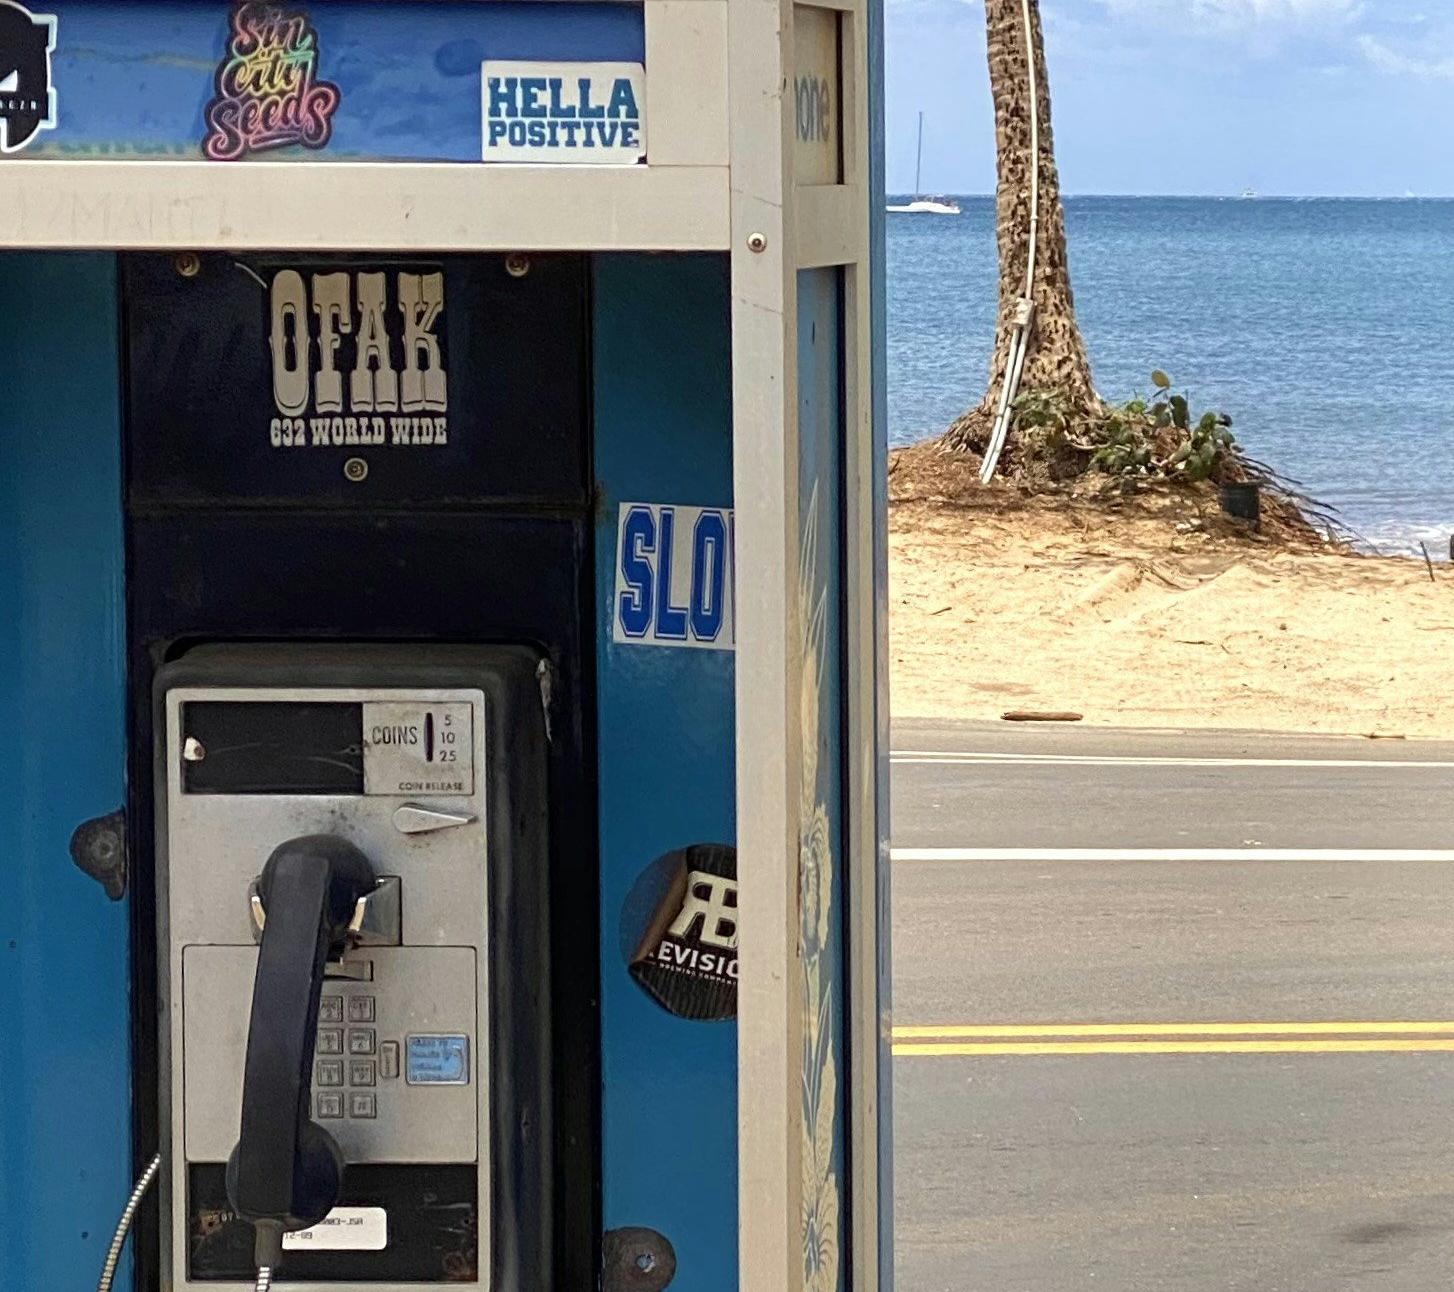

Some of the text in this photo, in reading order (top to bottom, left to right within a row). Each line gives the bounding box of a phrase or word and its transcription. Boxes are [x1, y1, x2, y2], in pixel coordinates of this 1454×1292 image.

[487, 77, 639, 119] HELLA
[207, 86, 337, 159] Seeds
[488, 120, 640, 148] POSITIVE
[268, 269, 448, 418] OFAK
[269, 416, 448, 447] 632 WORLD WIDE
[618, 505, 736, 645] SLO
[444, 714, 452, 727] 5
[371, 725, 418, 745] COINS
[440, 731, 456, 745] 10
[439, 750, 457, 763] 25
[398, 781, 463, 791] COIN RELEASE
